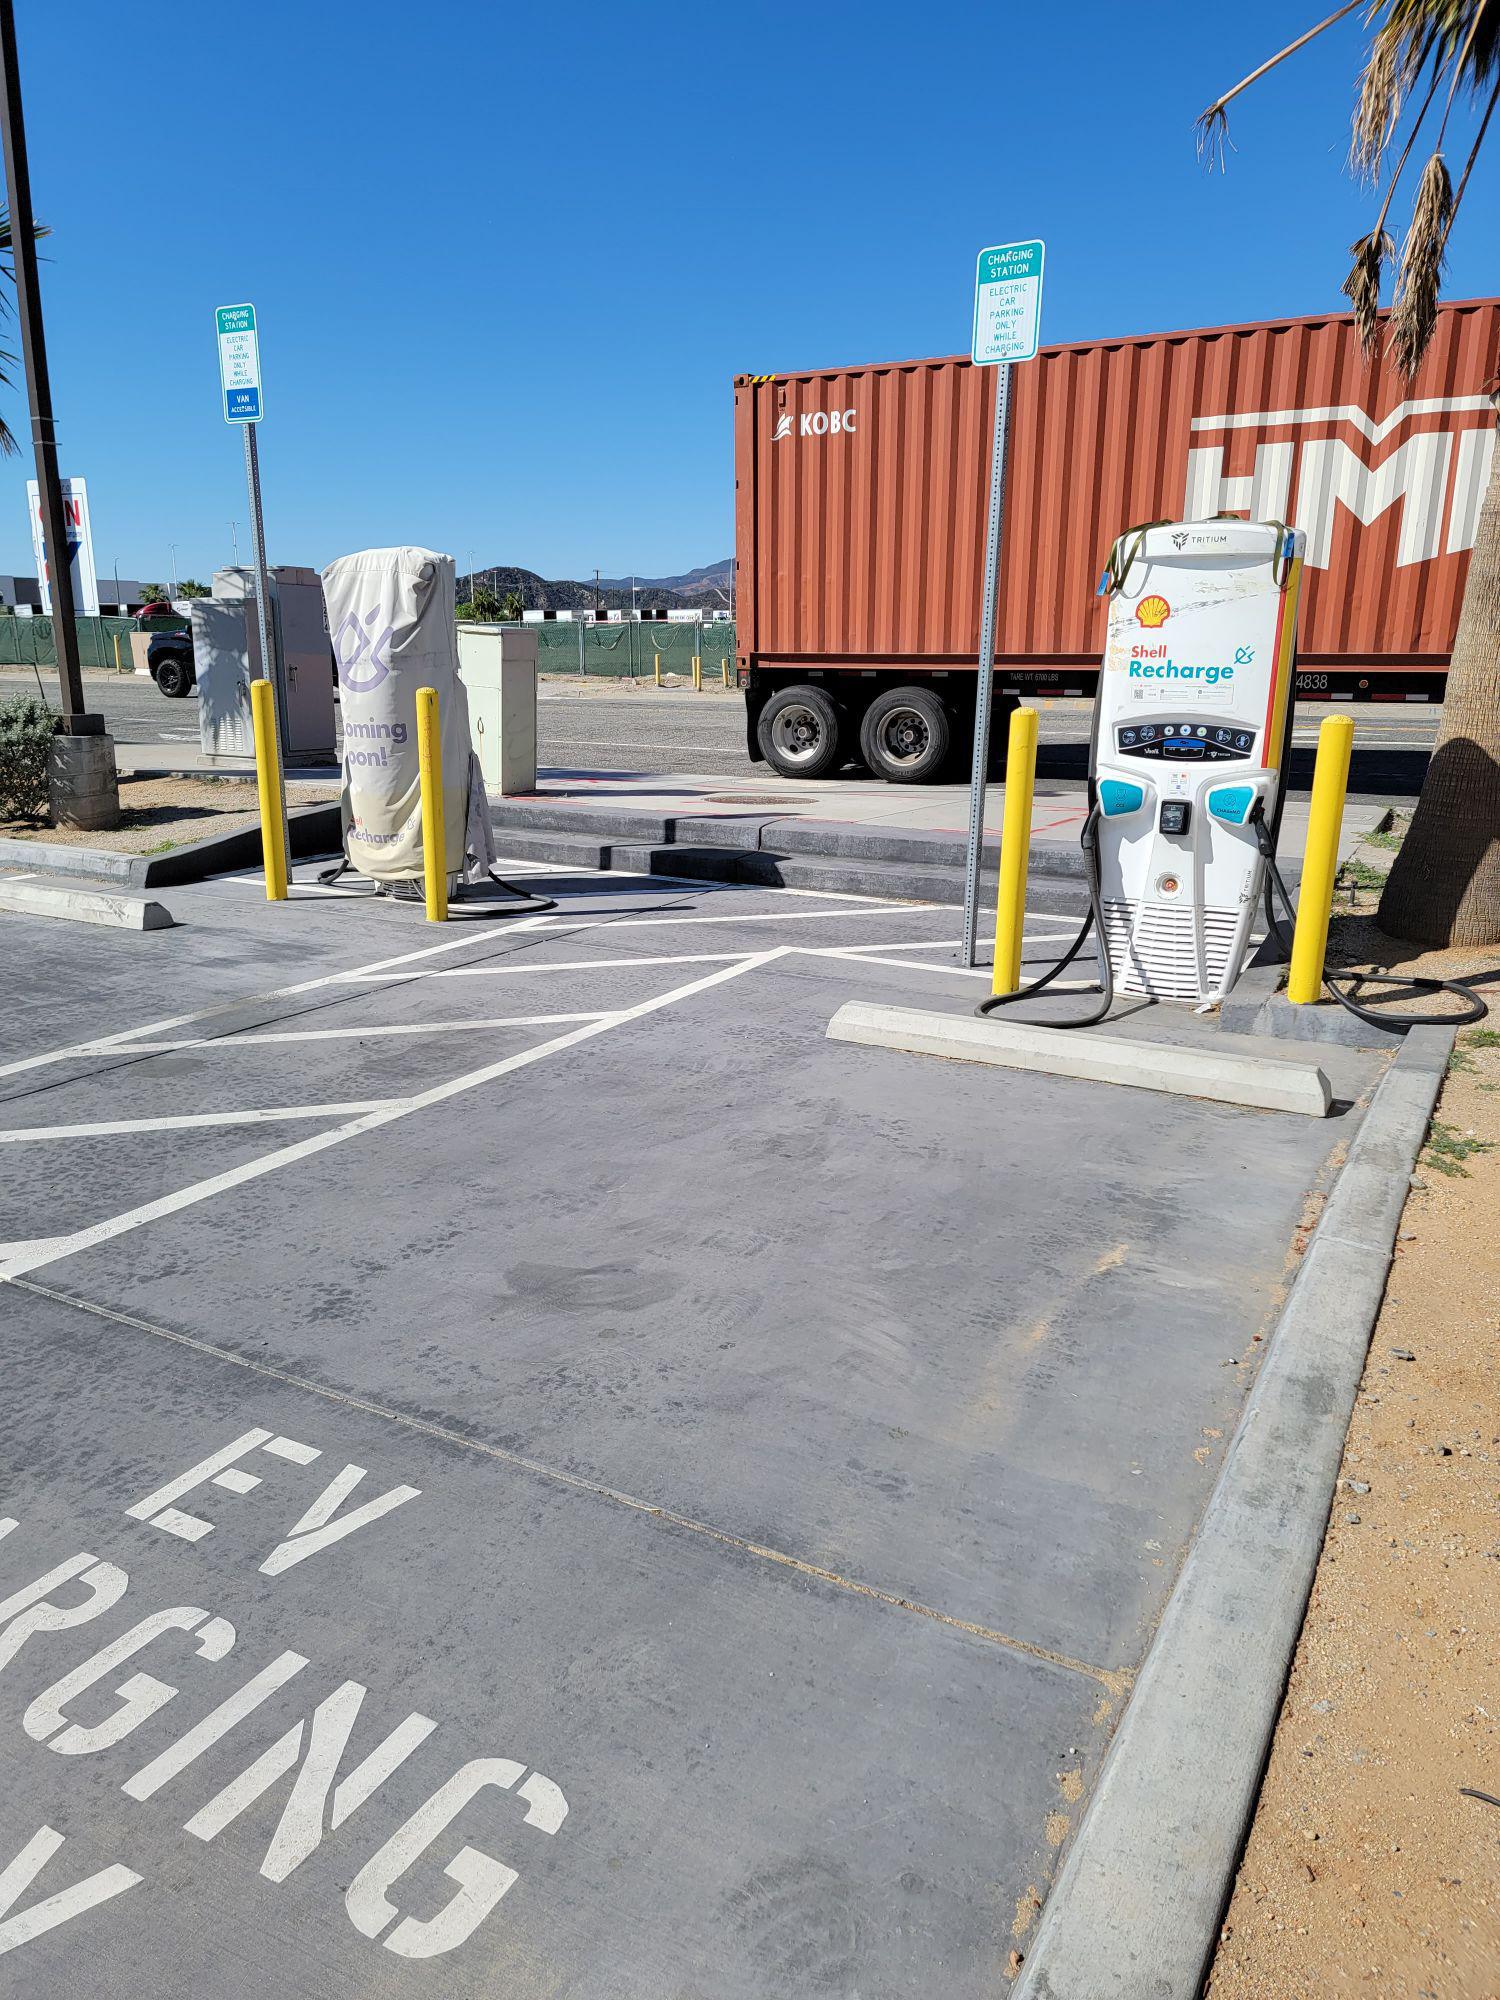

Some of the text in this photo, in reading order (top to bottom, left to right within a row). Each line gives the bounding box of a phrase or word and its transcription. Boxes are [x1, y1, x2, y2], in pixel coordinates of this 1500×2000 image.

[988, 249, 1033, 265] CHARGING
[991, 263, 1029, 278] STATION
[990, 284, 1027, 296] ELECTRIC
[1000, 297, 1015, 306] CAR
[222, 310, 249, 320] CHARGING
[990, 308, 1024, 319] PARKING
[225, 321, 248, 330] STATION
[995, 320, 1016, 330] ONLY
[226, 335, 249, 344] ELECTRIC
[994, 332, 1017, 341] WHILE
[985, 342, 1024, 354] CHARGING
[230, 378, 253, 386] CHARGING
[236, 395, 249, 403] VAN
[800, 409, 857, 436] KOBC
[1192, 536, 1227, 544] TRITIUM
[1131, 645, 1167, 658] Shell
[1129, 660, 1234, 684] Recharge
[1296, 674, 1328, 689] 4838
[125, 1427, 423, 1577] EV
